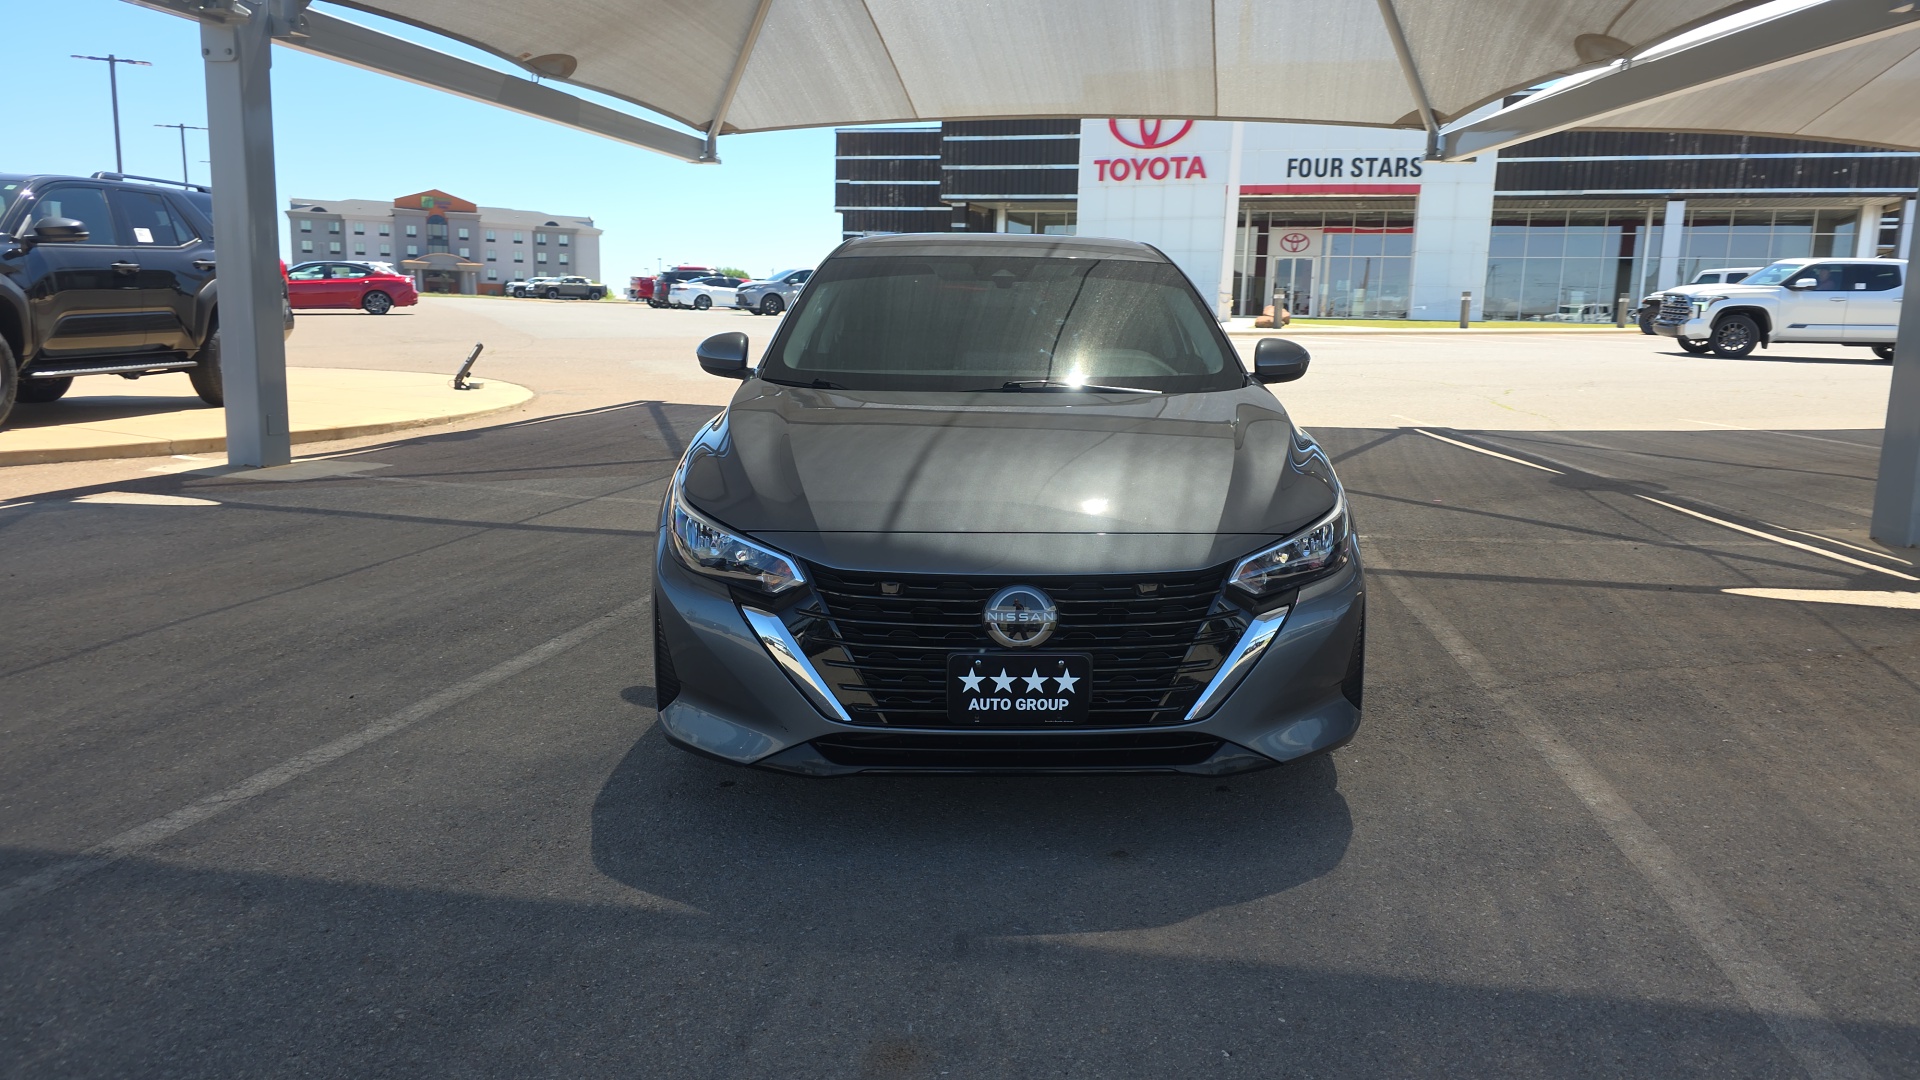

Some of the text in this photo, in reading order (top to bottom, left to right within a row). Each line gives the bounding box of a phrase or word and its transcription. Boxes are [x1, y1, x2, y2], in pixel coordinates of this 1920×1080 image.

[1093, 156, 1207, 182] TOYOTA
[1286, 157, 1423, 178] FOUR STARS
[987, 612, 1054, 622] NISSAN
[968, 698, 1069, 711] AUTO GROUP
